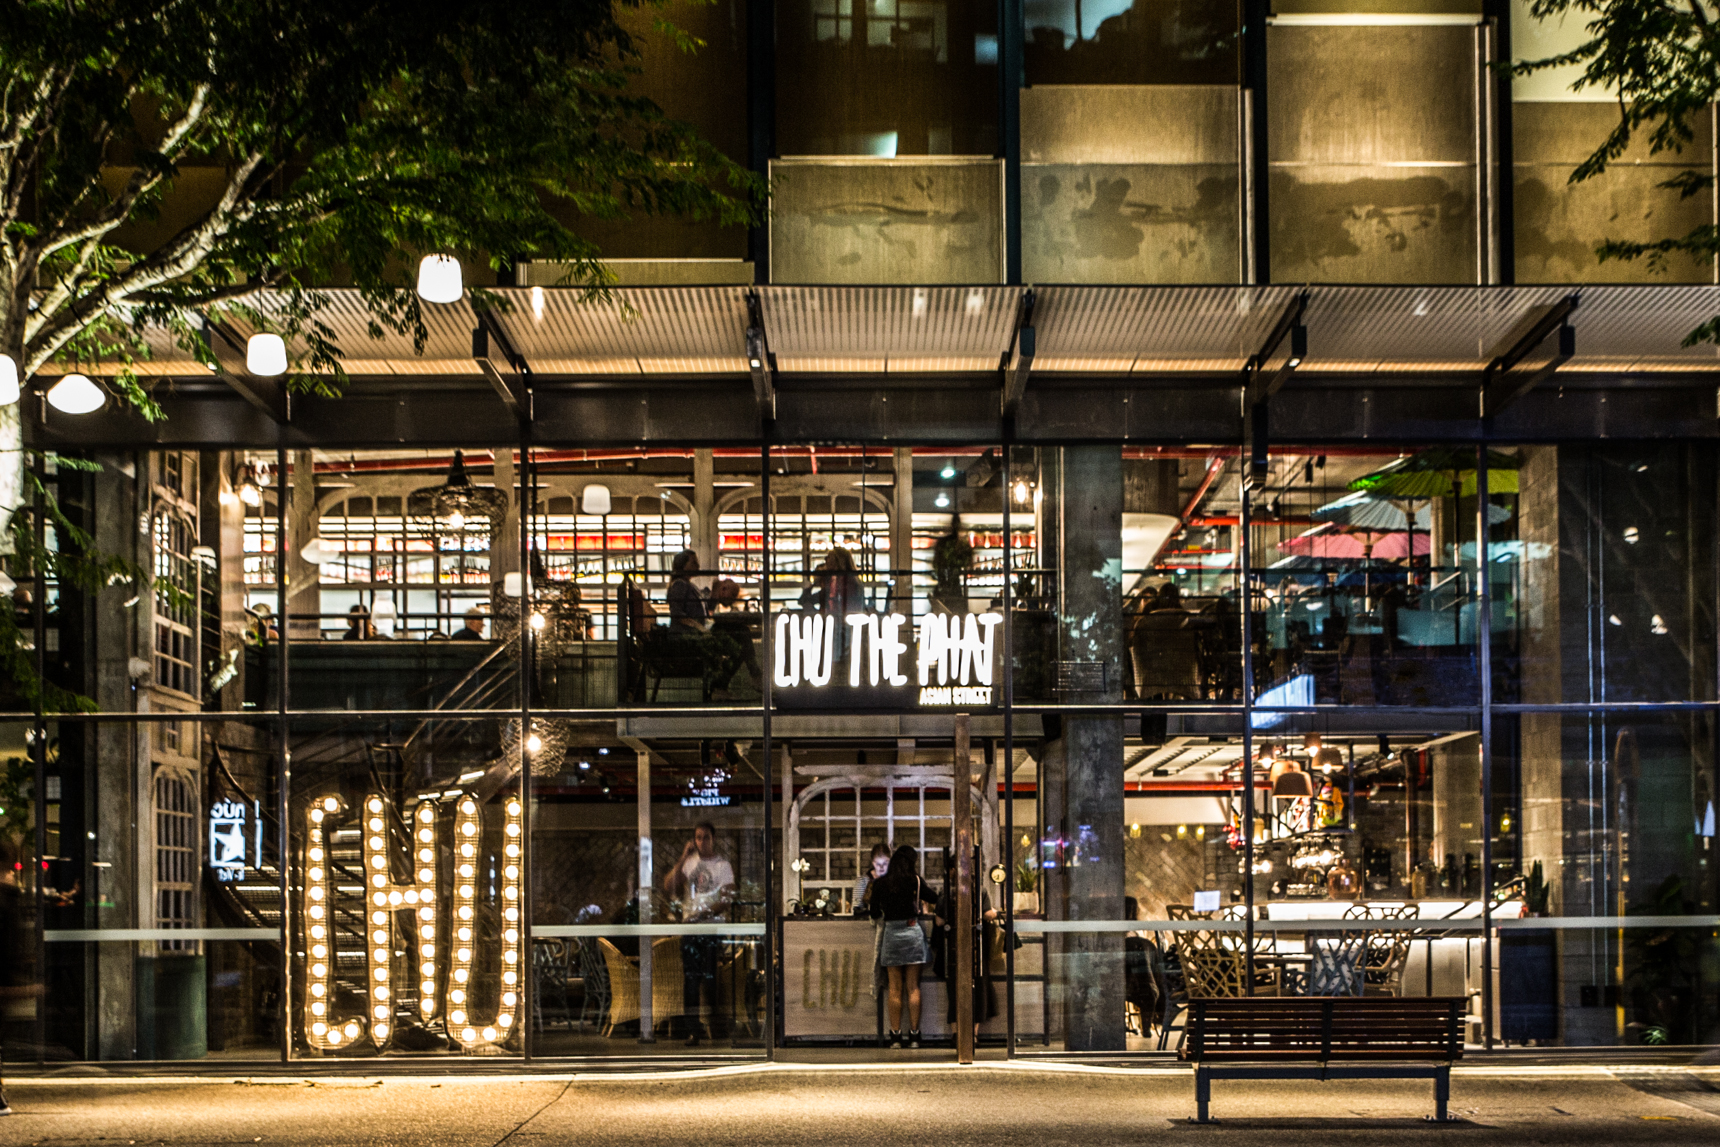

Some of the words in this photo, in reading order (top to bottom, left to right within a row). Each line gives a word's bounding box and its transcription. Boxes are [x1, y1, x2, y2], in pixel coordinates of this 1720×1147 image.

[774, 613, 834, 687] CHU
[845, 613, 908, 687] THE
[918, 612, 1003, 686] PHAT
[919, 686, 951, 705] ASIAN
[952, 686, 993, 705] STREET
[304, 792, 523, 1053] CHU
[802, 949, 860, 1008] CHU
